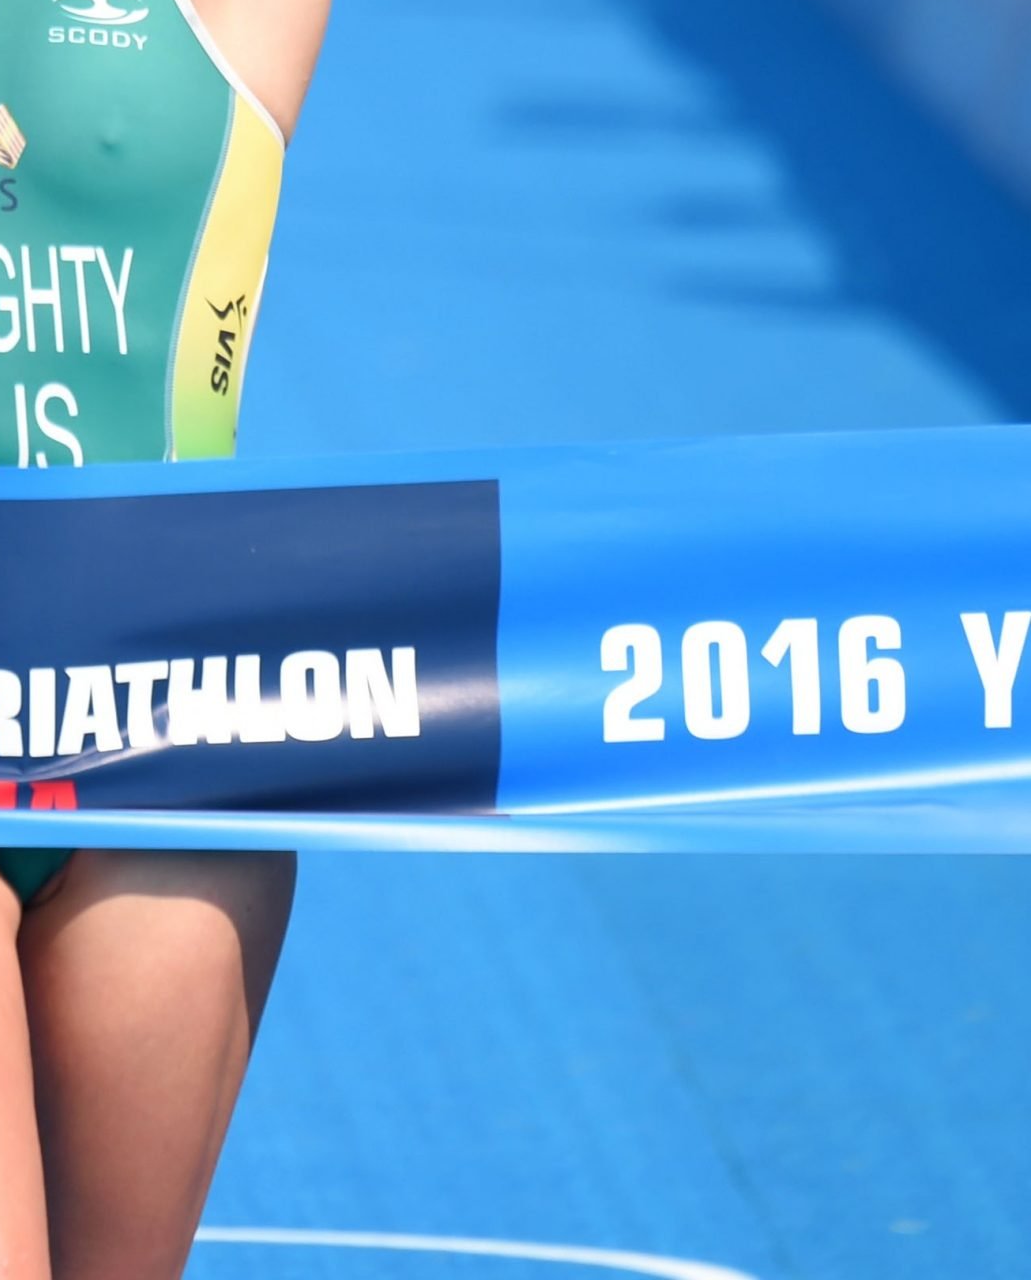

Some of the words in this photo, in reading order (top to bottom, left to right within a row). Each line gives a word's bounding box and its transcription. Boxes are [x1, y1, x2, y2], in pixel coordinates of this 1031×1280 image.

[48, 26, 148, 51] SCODY
[211, 329, 236, 396] VIS
[600, 614, 906, 743] 2016
[960, 610, 1031, 729] Y
